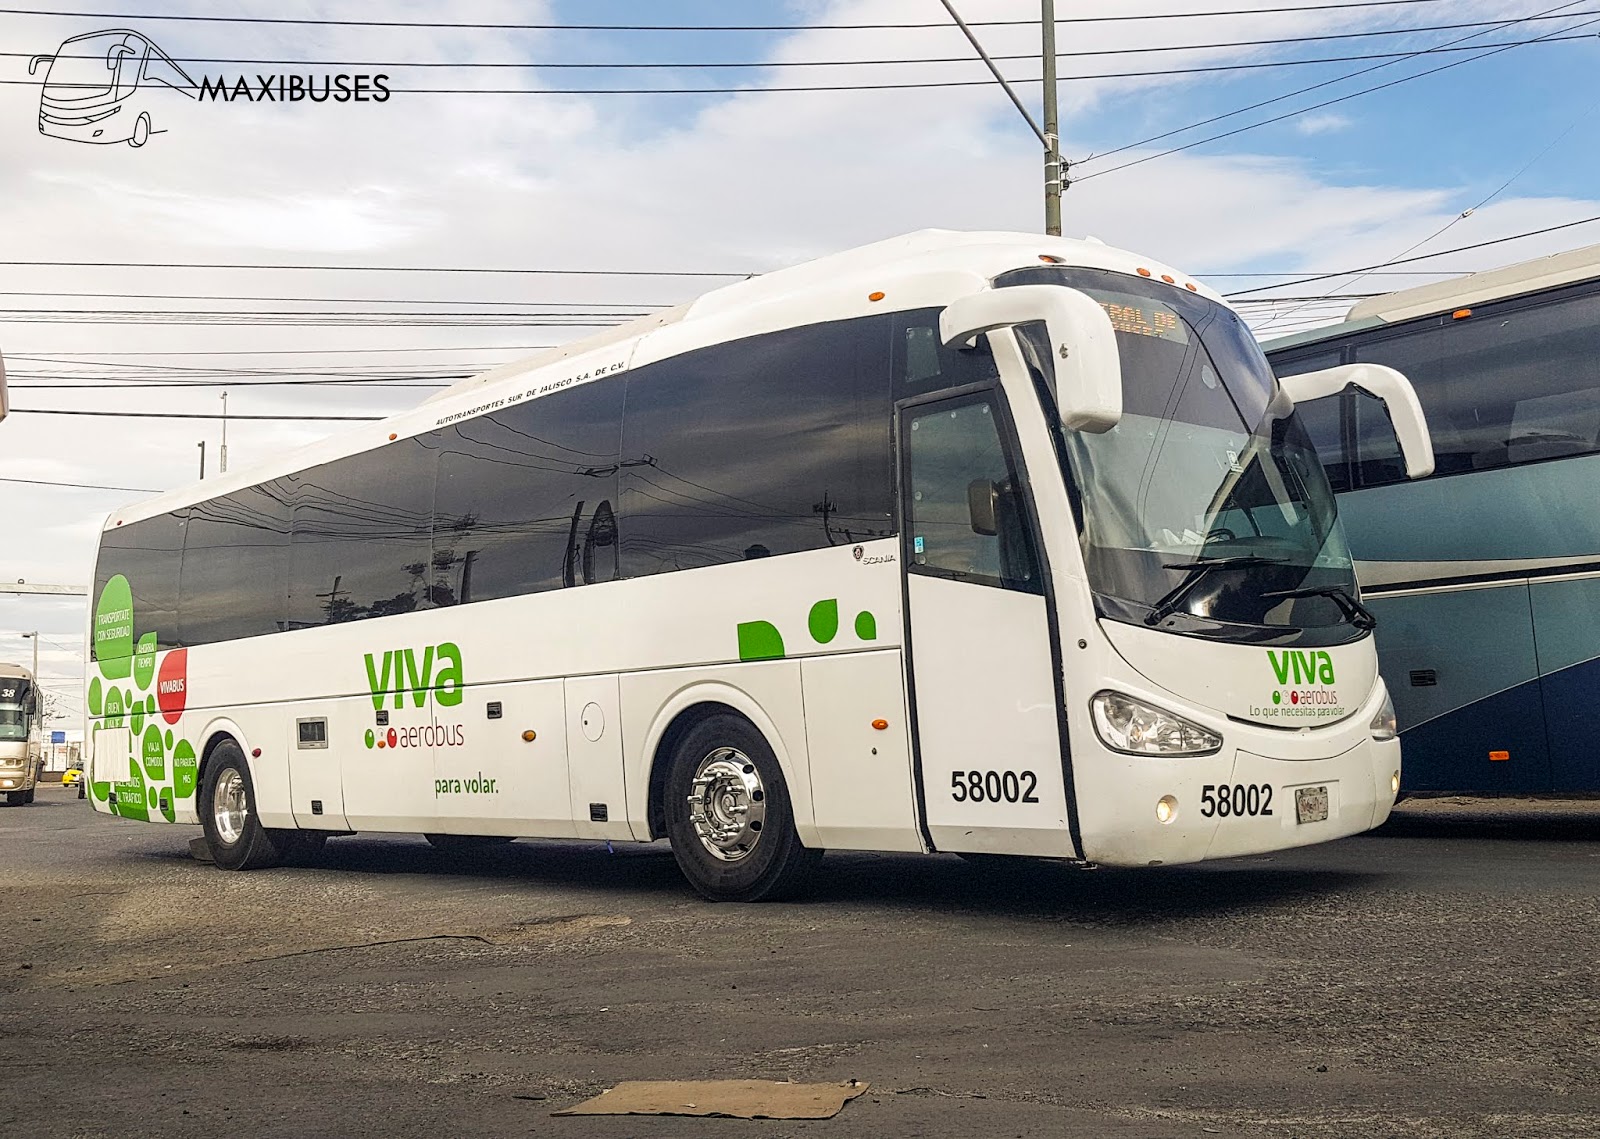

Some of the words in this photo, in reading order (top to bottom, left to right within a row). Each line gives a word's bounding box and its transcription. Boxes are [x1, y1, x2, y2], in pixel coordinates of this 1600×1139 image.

[435, 399, 505, 426] AUTOTRANSPORTES
[507, 393, 523, 404] SUR
[526, 388, 537, 397] DE
[539, 378, 572, 394] JALISCO
[575, 373, 591, 383] S.A.
[595, 366, 607, 376] DE
[160, 678, 185, 694] VIVABUS
[1300, 685, 1337, 704] aerobus
[1249, 705, 1260, 716] Lo
[1263, 707, 1279, 718] que
[1281, 706, 1316, 716] necesitas
[400, 716, 464, 748] aerobus
[435, 778, 461, 799] para
[463, 771, 499, 794] volar.
[952, 771, 1039, 803] 58002
[1200, 784, 1273, 817] 58002
